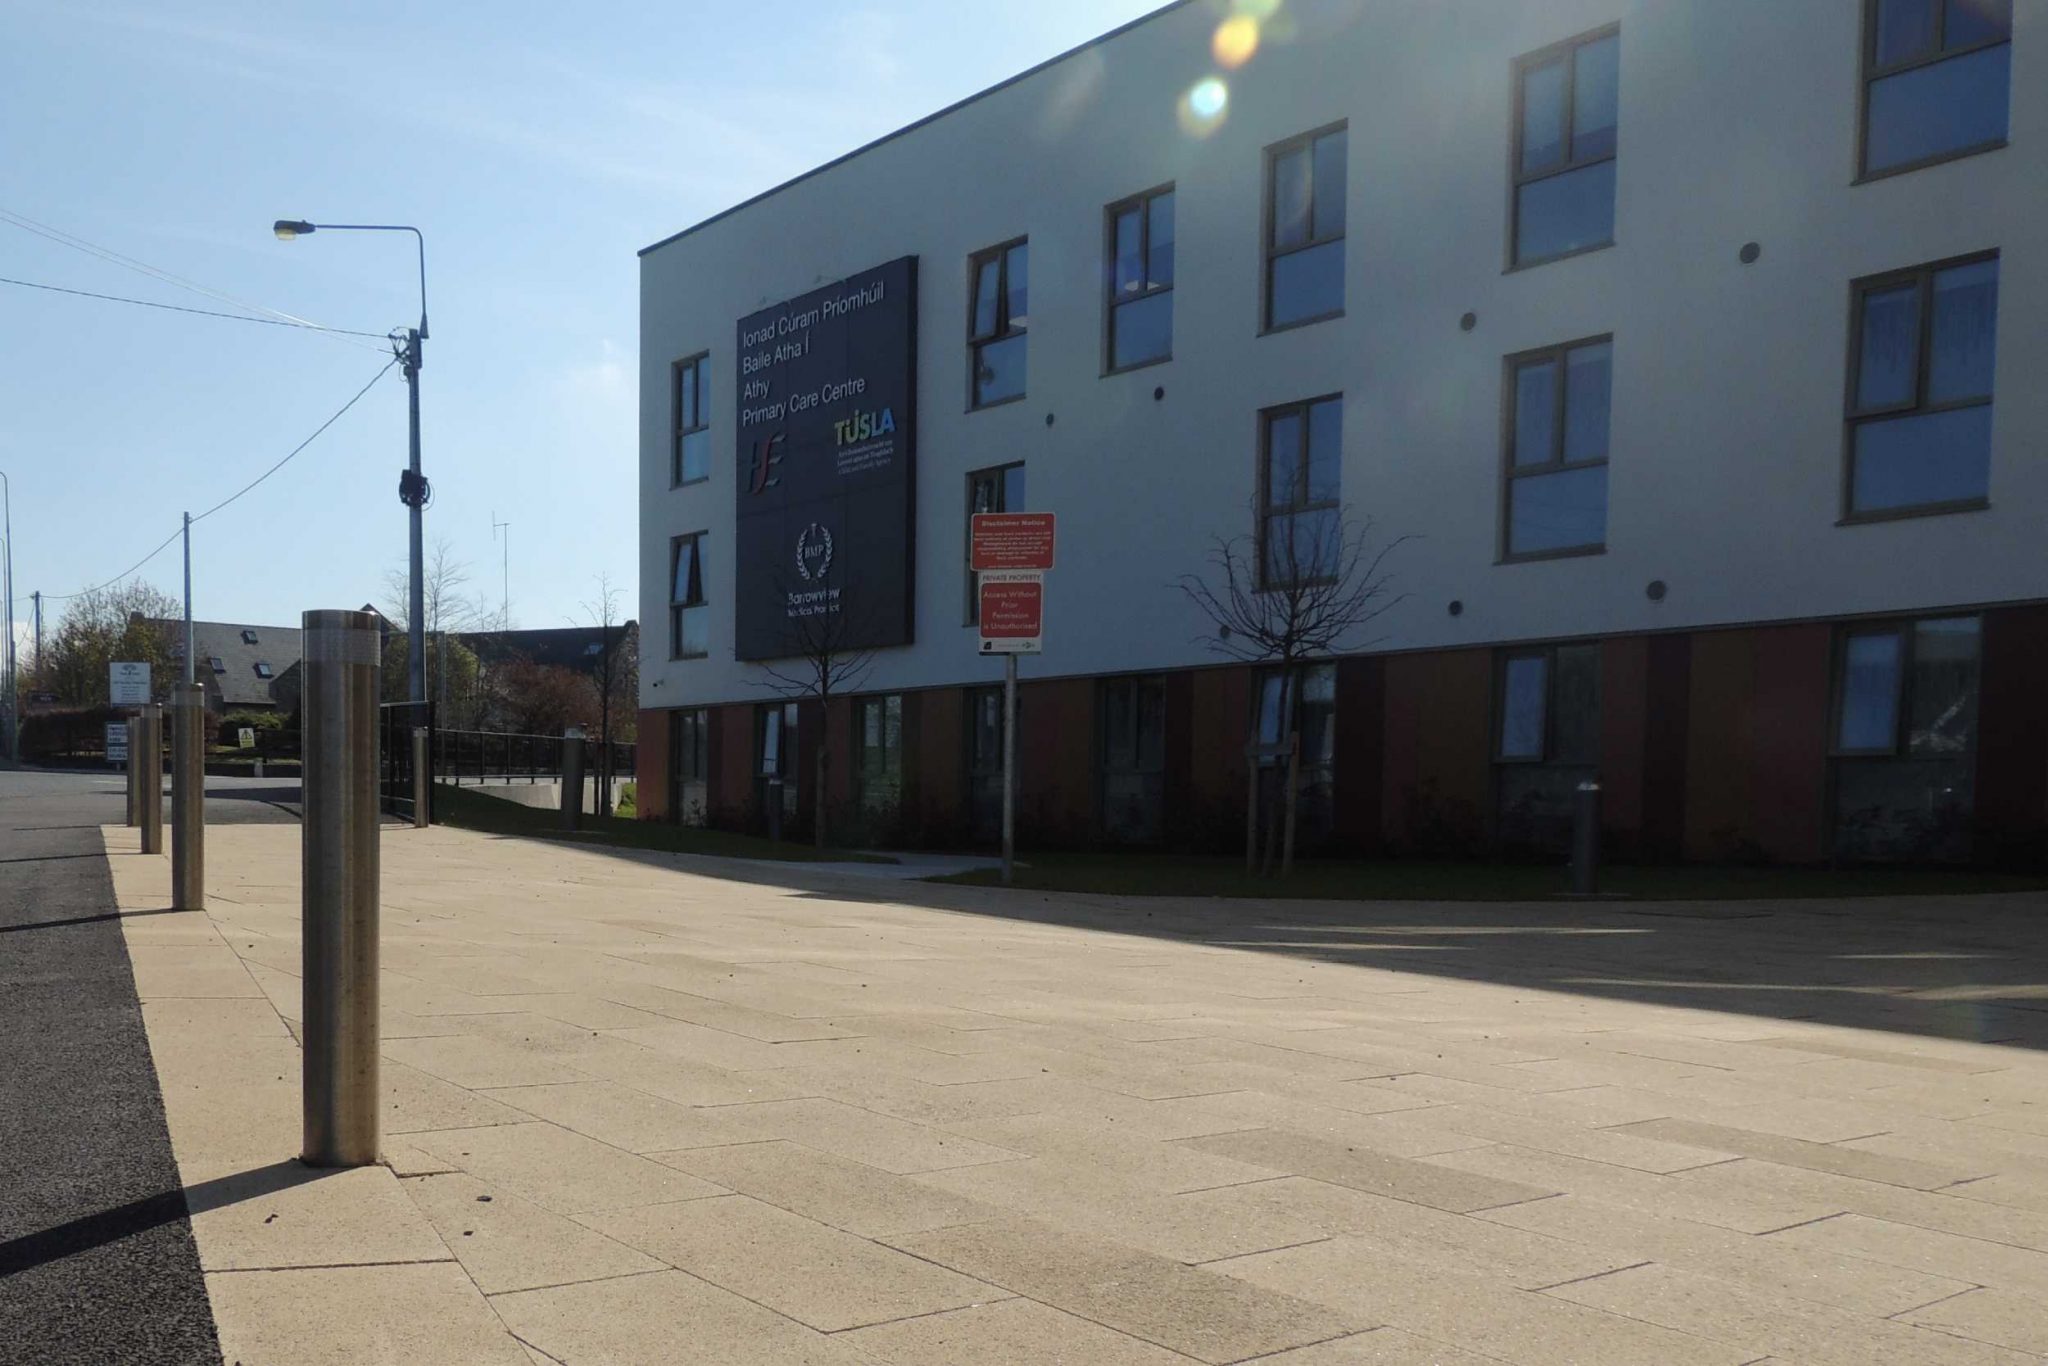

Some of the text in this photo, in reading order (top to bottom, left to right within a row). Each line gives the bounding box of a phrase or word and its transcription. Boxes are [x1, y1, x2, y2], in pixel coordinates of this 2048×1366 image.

[743, 280, 885, 348] Ionad Cúram Príomhúil
[743, 352, 772, 375] Baile
[743, 378, 770, 401] Athy
[742, 376, 866, 427] Primary Care Centre
[804, 543, 825, 559] BMP
[983, 573, 1041, 582] PRIVATE PROPERTY
[814, 602, 841, 615] Pracice
